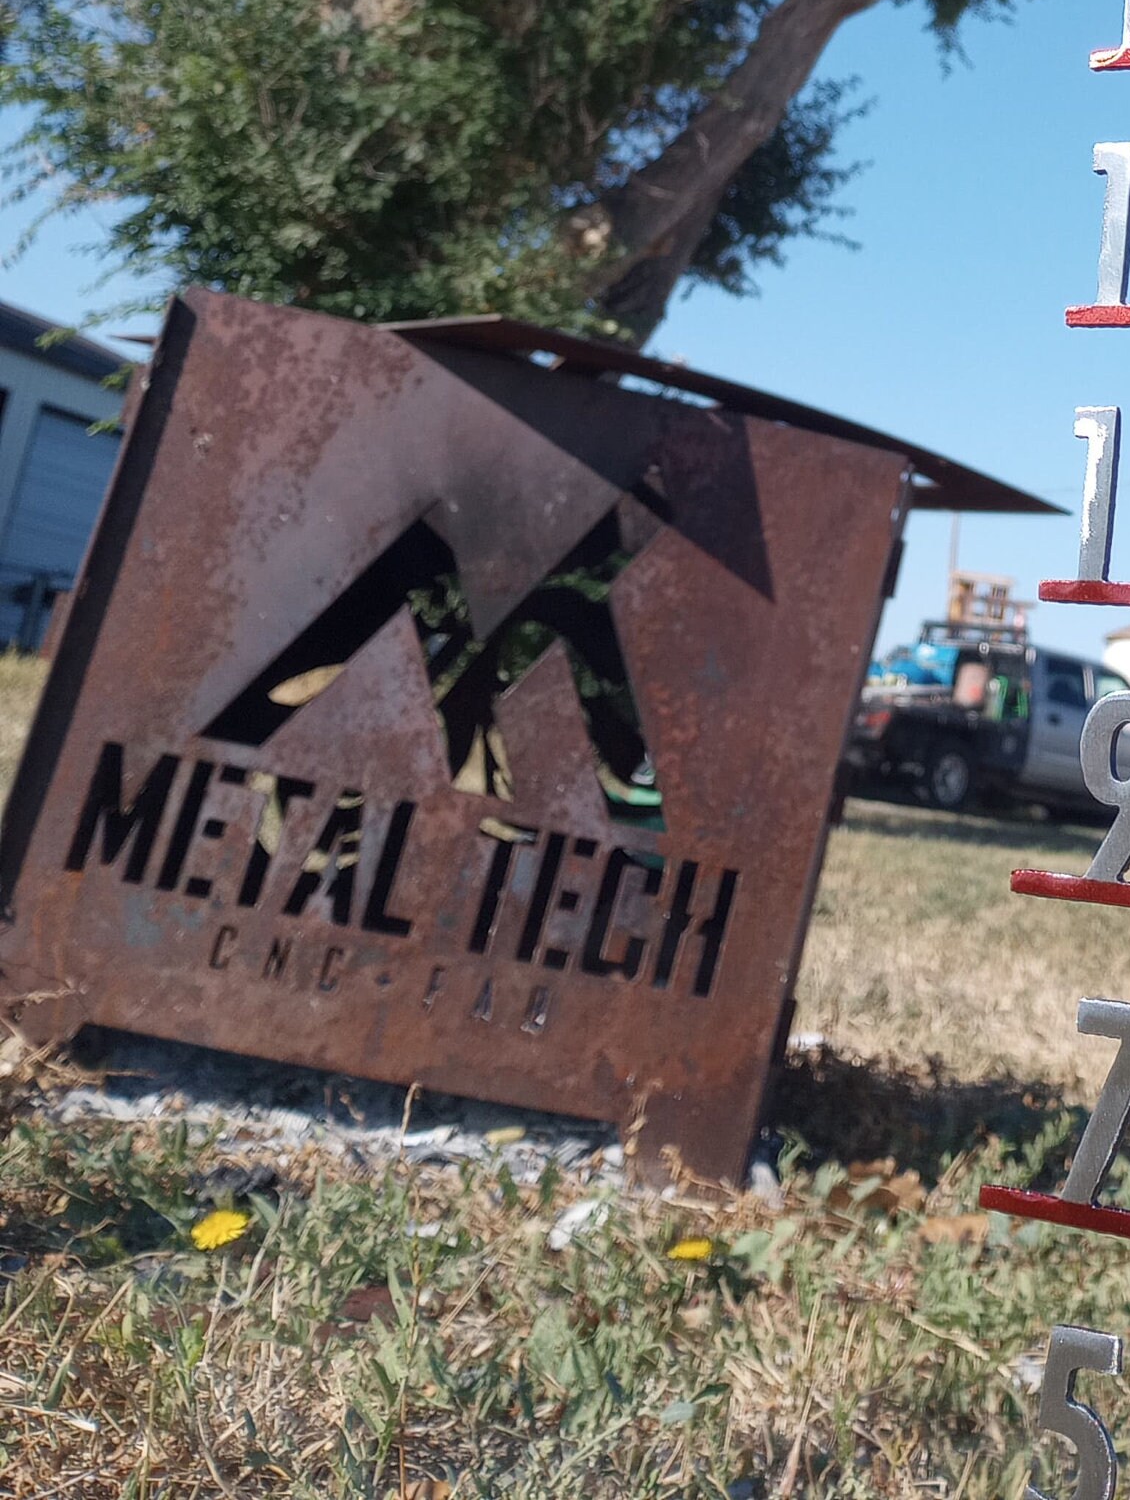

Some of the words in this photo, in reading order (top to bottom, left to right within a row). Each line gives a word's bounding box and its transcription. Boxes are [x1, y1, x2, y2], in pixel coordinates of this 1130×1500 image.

[64, 742, 415, 937] METAL
[469, 815, 741, 998] TECH
[209, 925, 343, 992] CNC
[1024, 1324, 1123, 1500] 5
